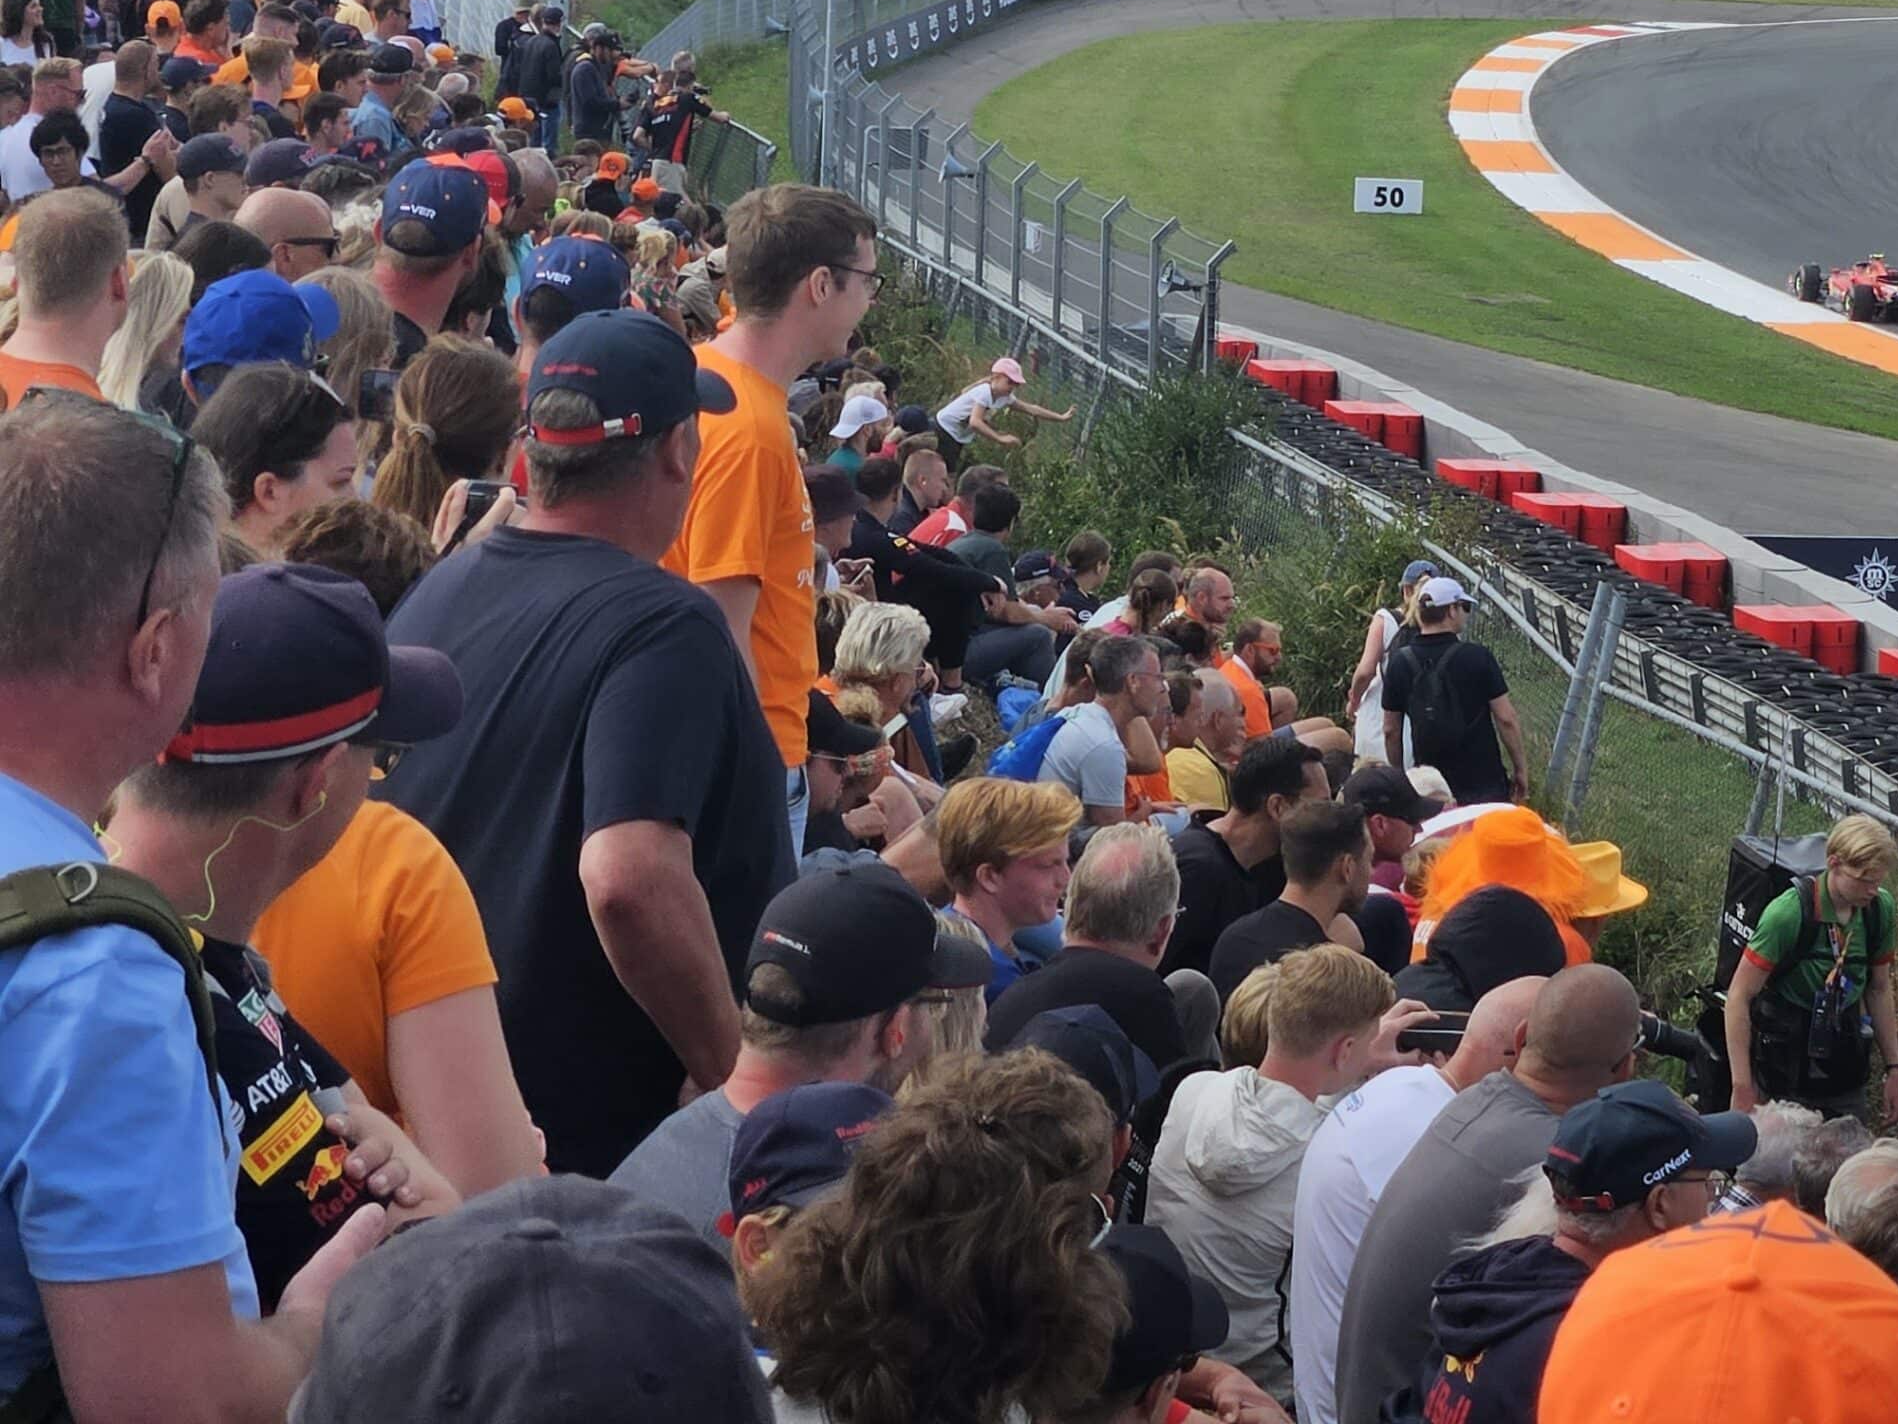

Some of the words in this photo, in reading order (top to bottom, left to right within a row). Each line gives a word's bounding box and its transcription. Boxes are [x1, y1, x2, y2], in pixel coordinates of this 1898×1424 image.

[1374, 186, 1404, 208] 50
[411, 204, 437, 220] VER
[546, 271, 572, 286] VER
[247, 1061, 294, 1113] AT&T
[1642, 1148, 1692, 1185] CarNext
